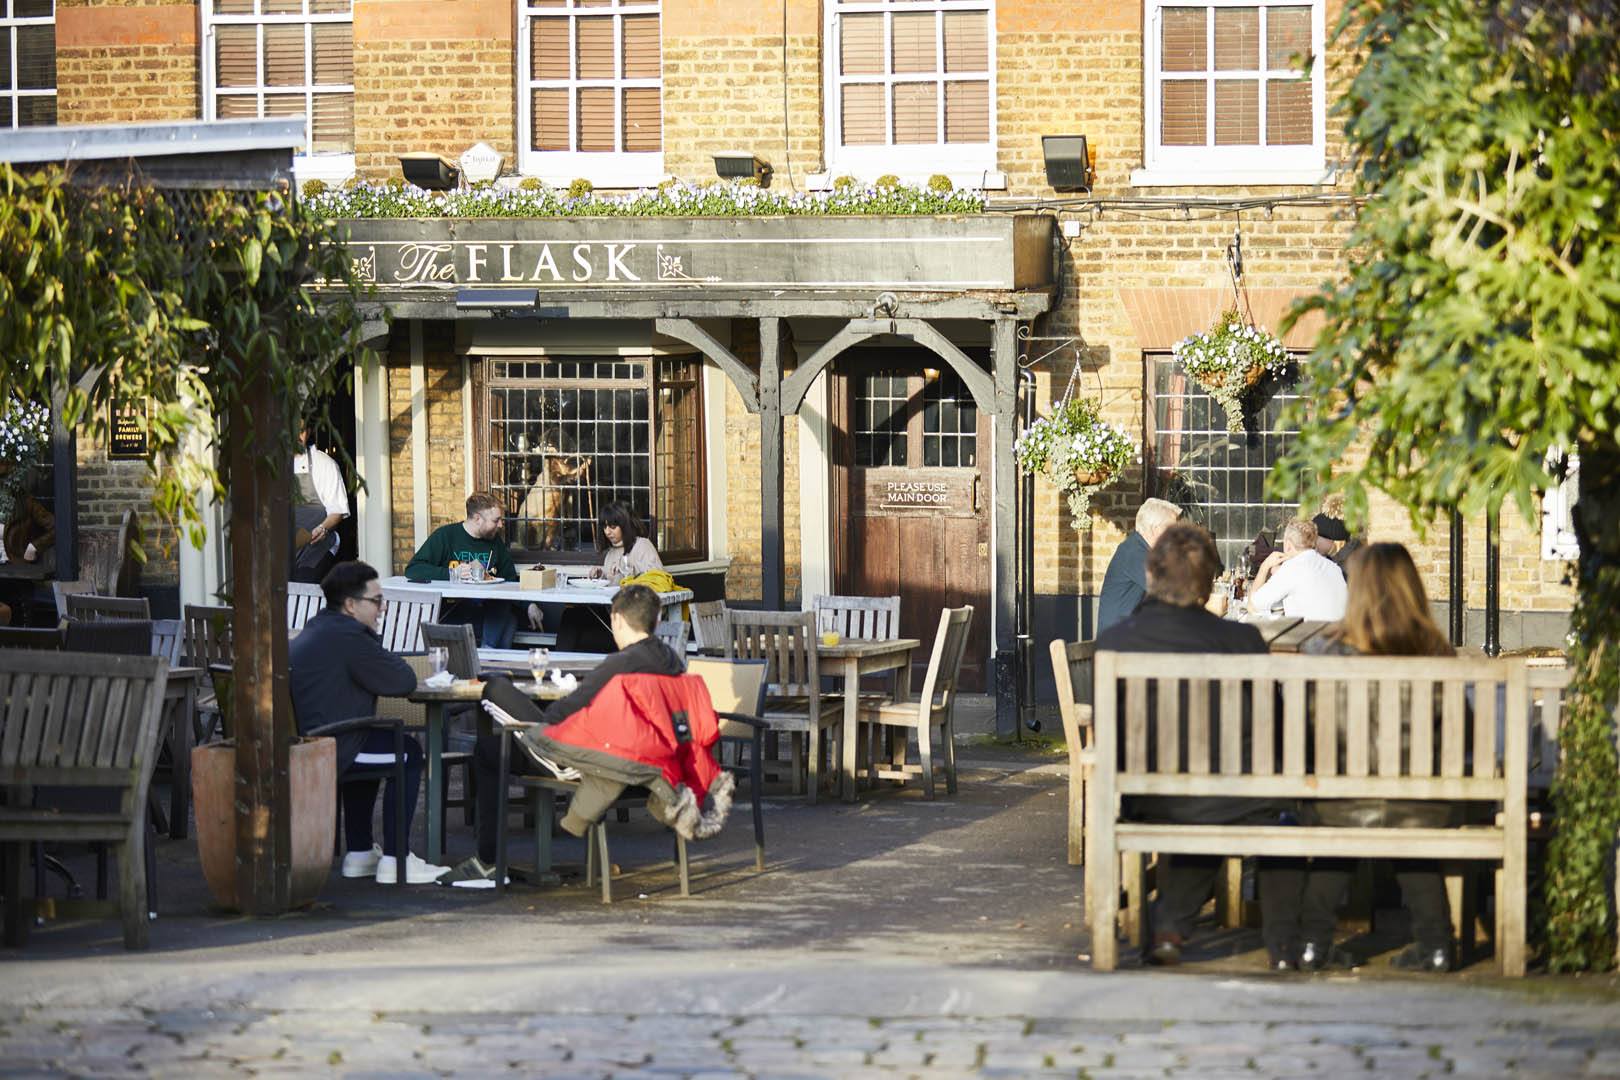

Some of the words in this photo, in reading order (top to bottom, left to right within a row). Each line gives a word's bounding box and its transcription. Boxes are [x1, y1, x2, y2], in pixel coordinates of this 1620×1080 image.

[394, 243, 456, 282] The
[465, 243, 641, 282] FLASK
[887, 481, 926, 491] PLEASE
[927, 482, 946, 492] USE
[887, 493, 915, 502] MAIN
[916, 493, 947, 502] DOOR
